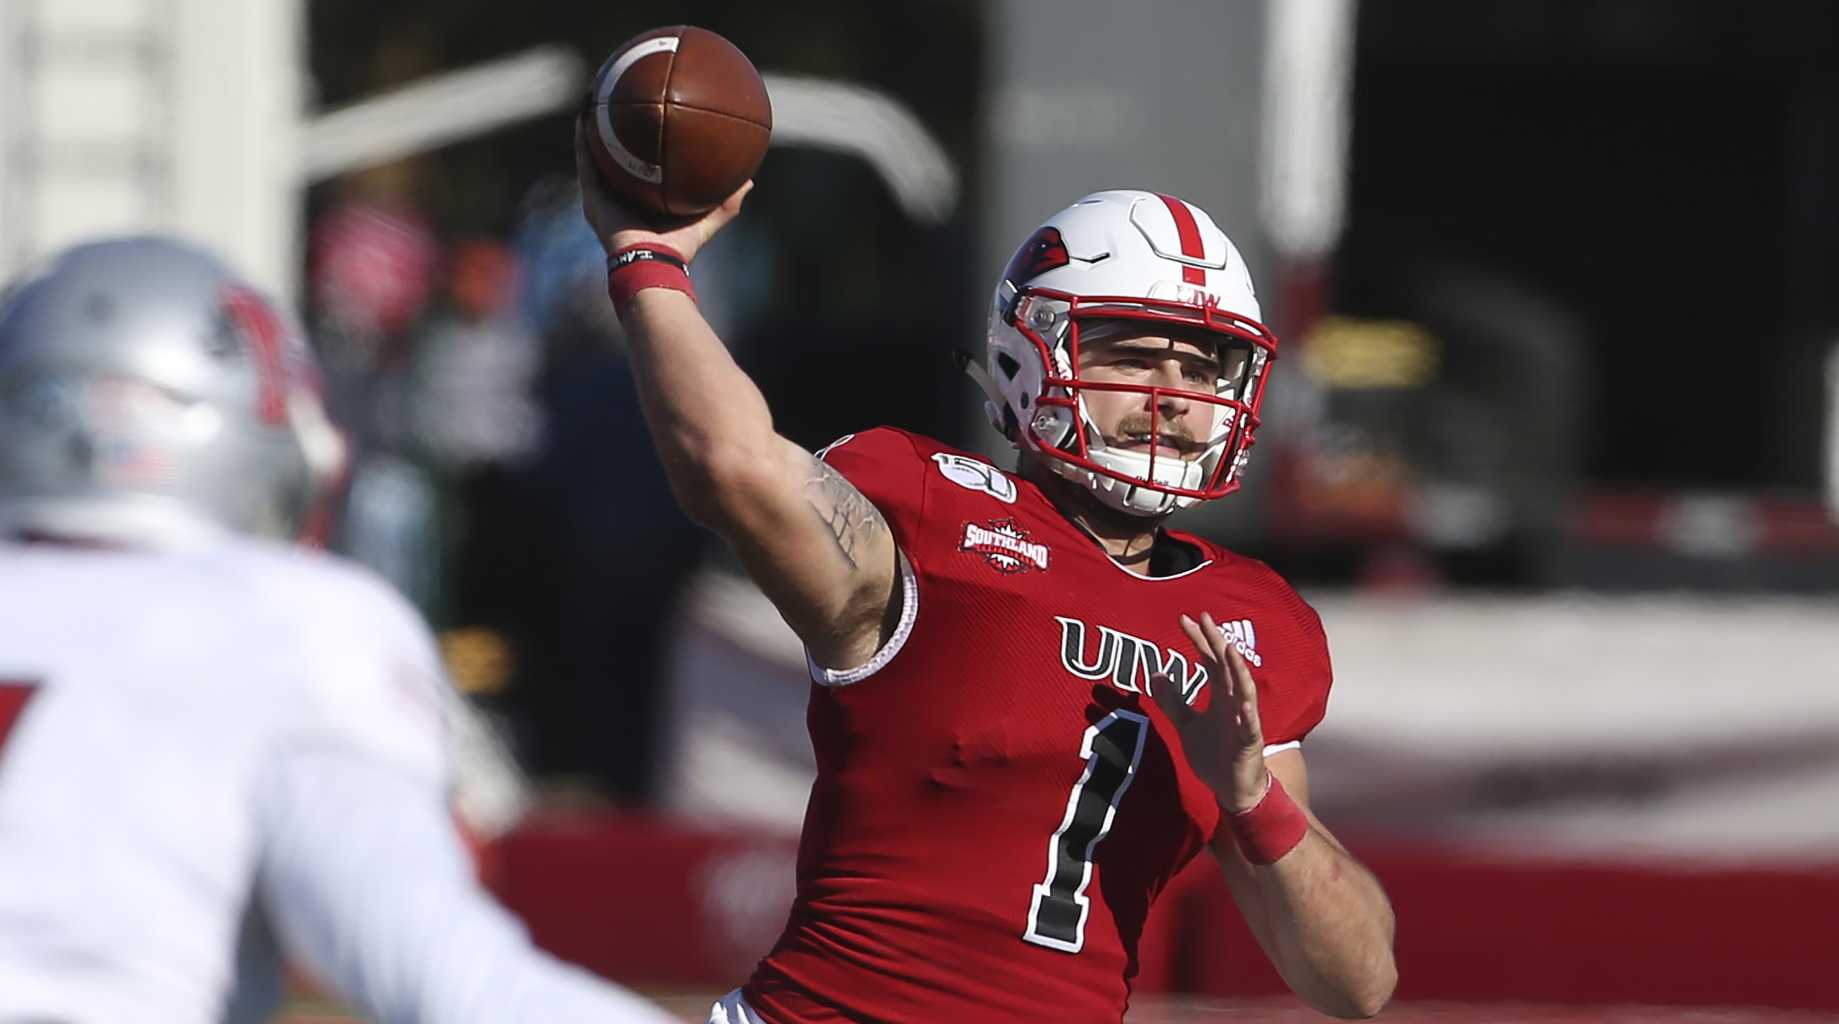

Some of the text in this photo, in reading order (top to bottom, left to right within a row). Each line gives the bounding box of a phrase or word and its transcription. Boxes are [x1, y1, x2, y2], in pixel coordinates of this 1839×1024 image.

[963, 523, 1048, 569] SOUTHLAND
[1055, 615, 1208, 706] UIW
[1022, 708, 1149, 954] 1
